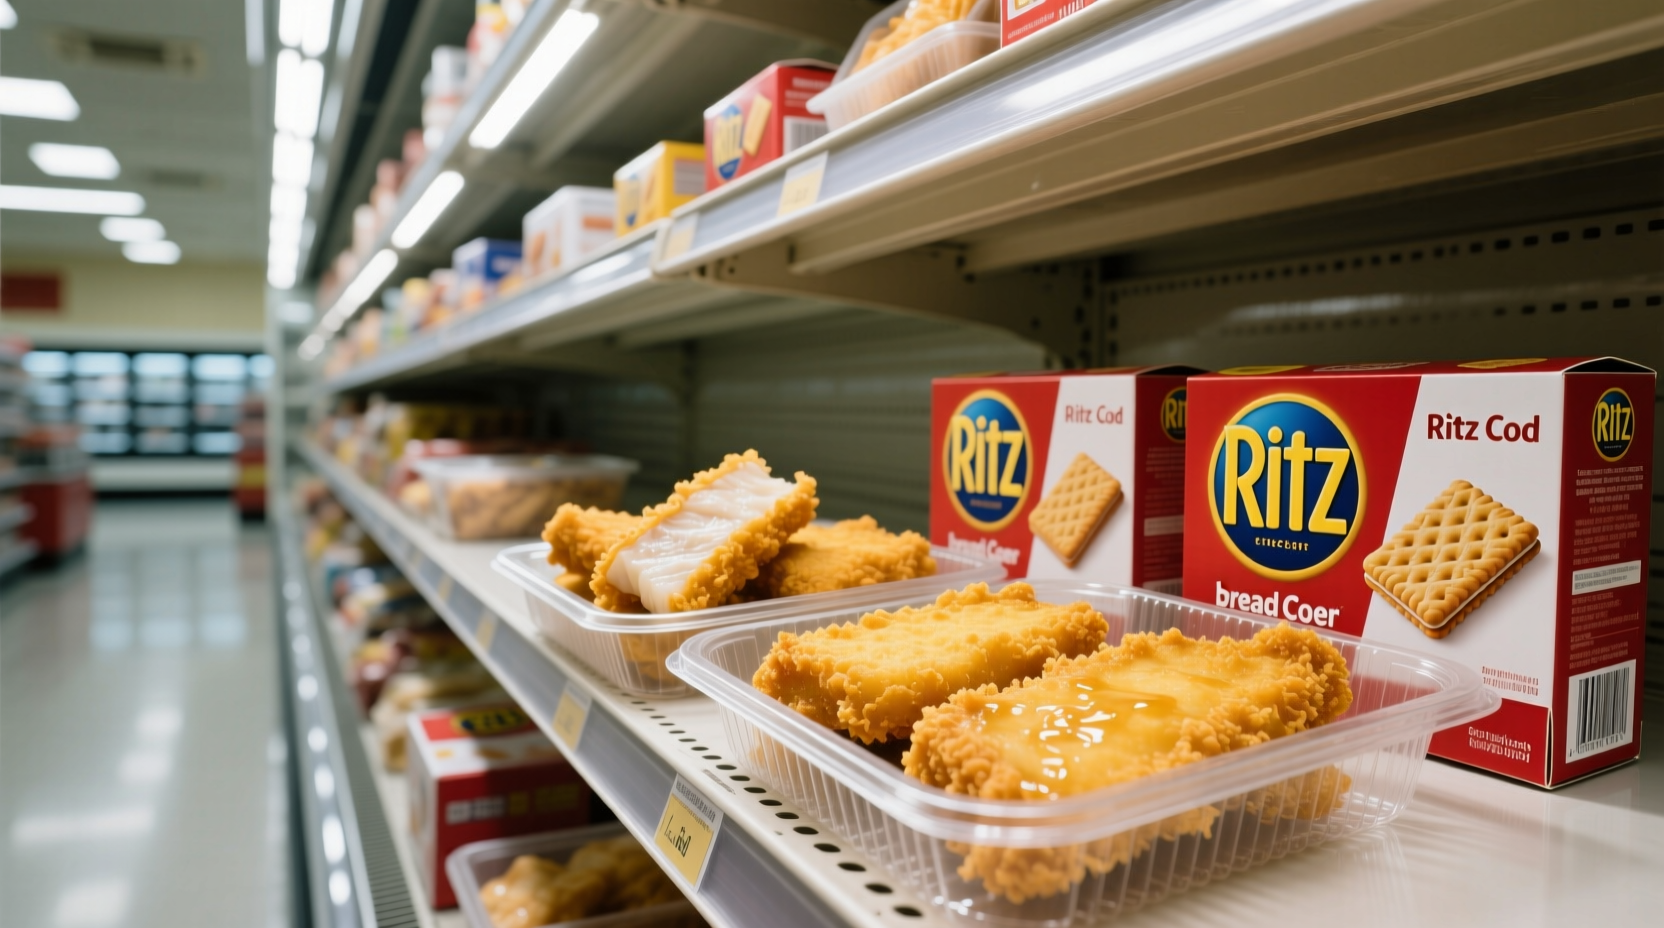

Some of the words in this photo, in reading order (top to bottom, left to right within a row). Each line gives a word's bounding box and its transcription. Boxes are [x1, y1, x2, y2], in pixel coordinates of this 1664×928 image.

[1065, 405, 1092, 423] Ritz
[1096, 405, 1123, 424] Cod
[1427, 412, 1479, 440] Ritz
[1485, 414, 1540, 443] Cod
[951, 414, 1024, 498] Ritz
[1223, 424, 1350, 535] Ritz
[1216, 580, 1279, 618] bread
[1282, 594, 1340, 628] Coer
